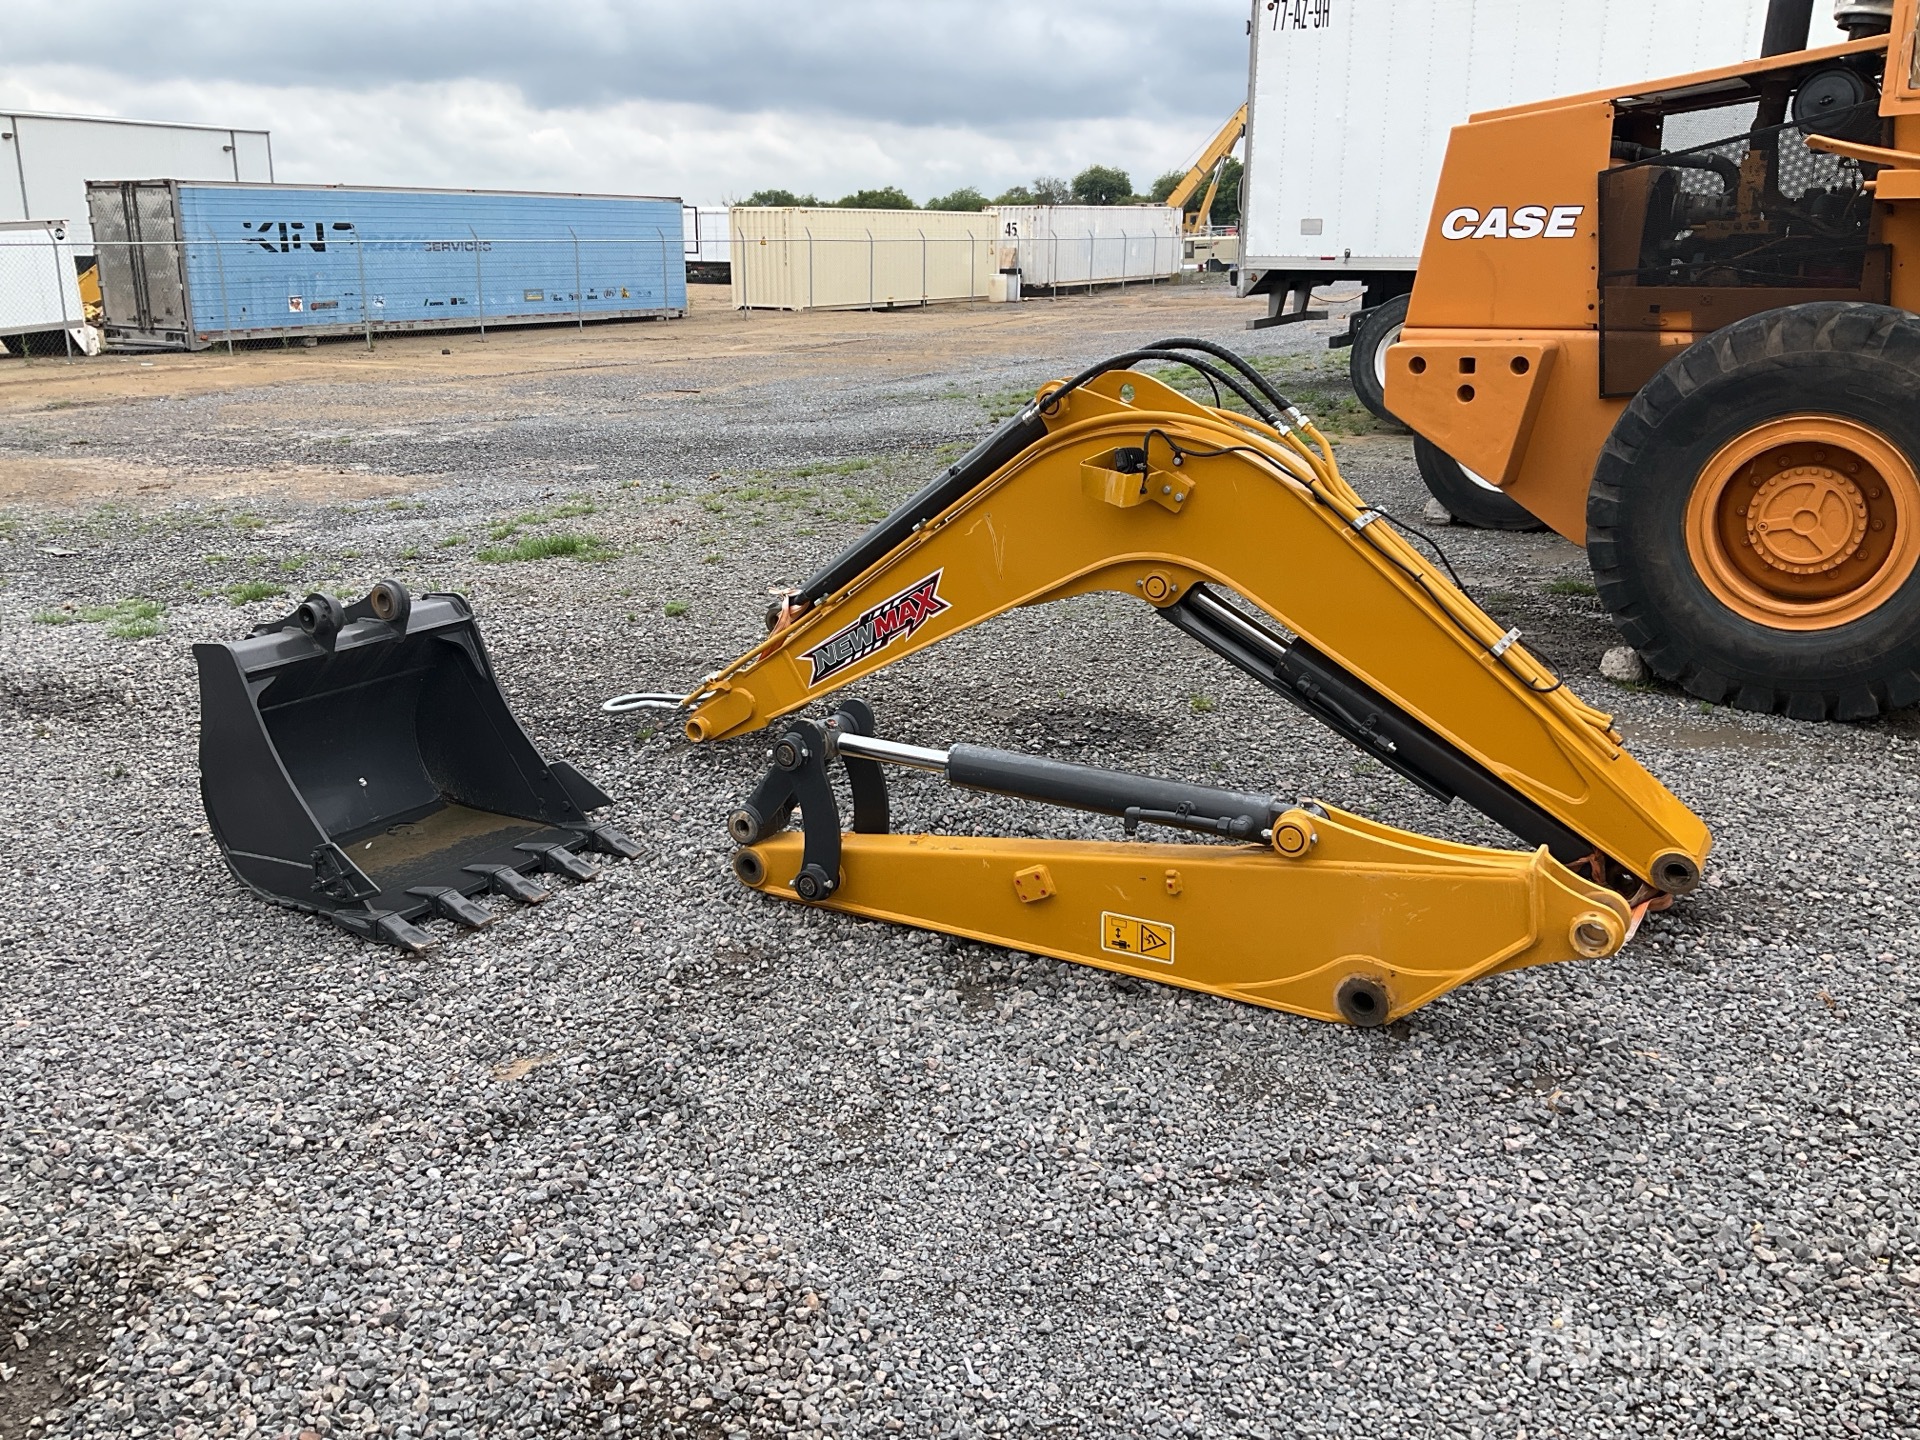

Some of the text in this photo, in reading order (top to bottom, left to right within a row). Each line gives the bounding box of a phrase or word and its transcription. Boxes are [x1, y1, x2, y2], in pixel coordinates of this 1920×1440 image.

[1005, 222, 1018, 237] 45
[1441, 205, 1585, 240] CASE
[813, 585, 942, 676] NEWMAX
